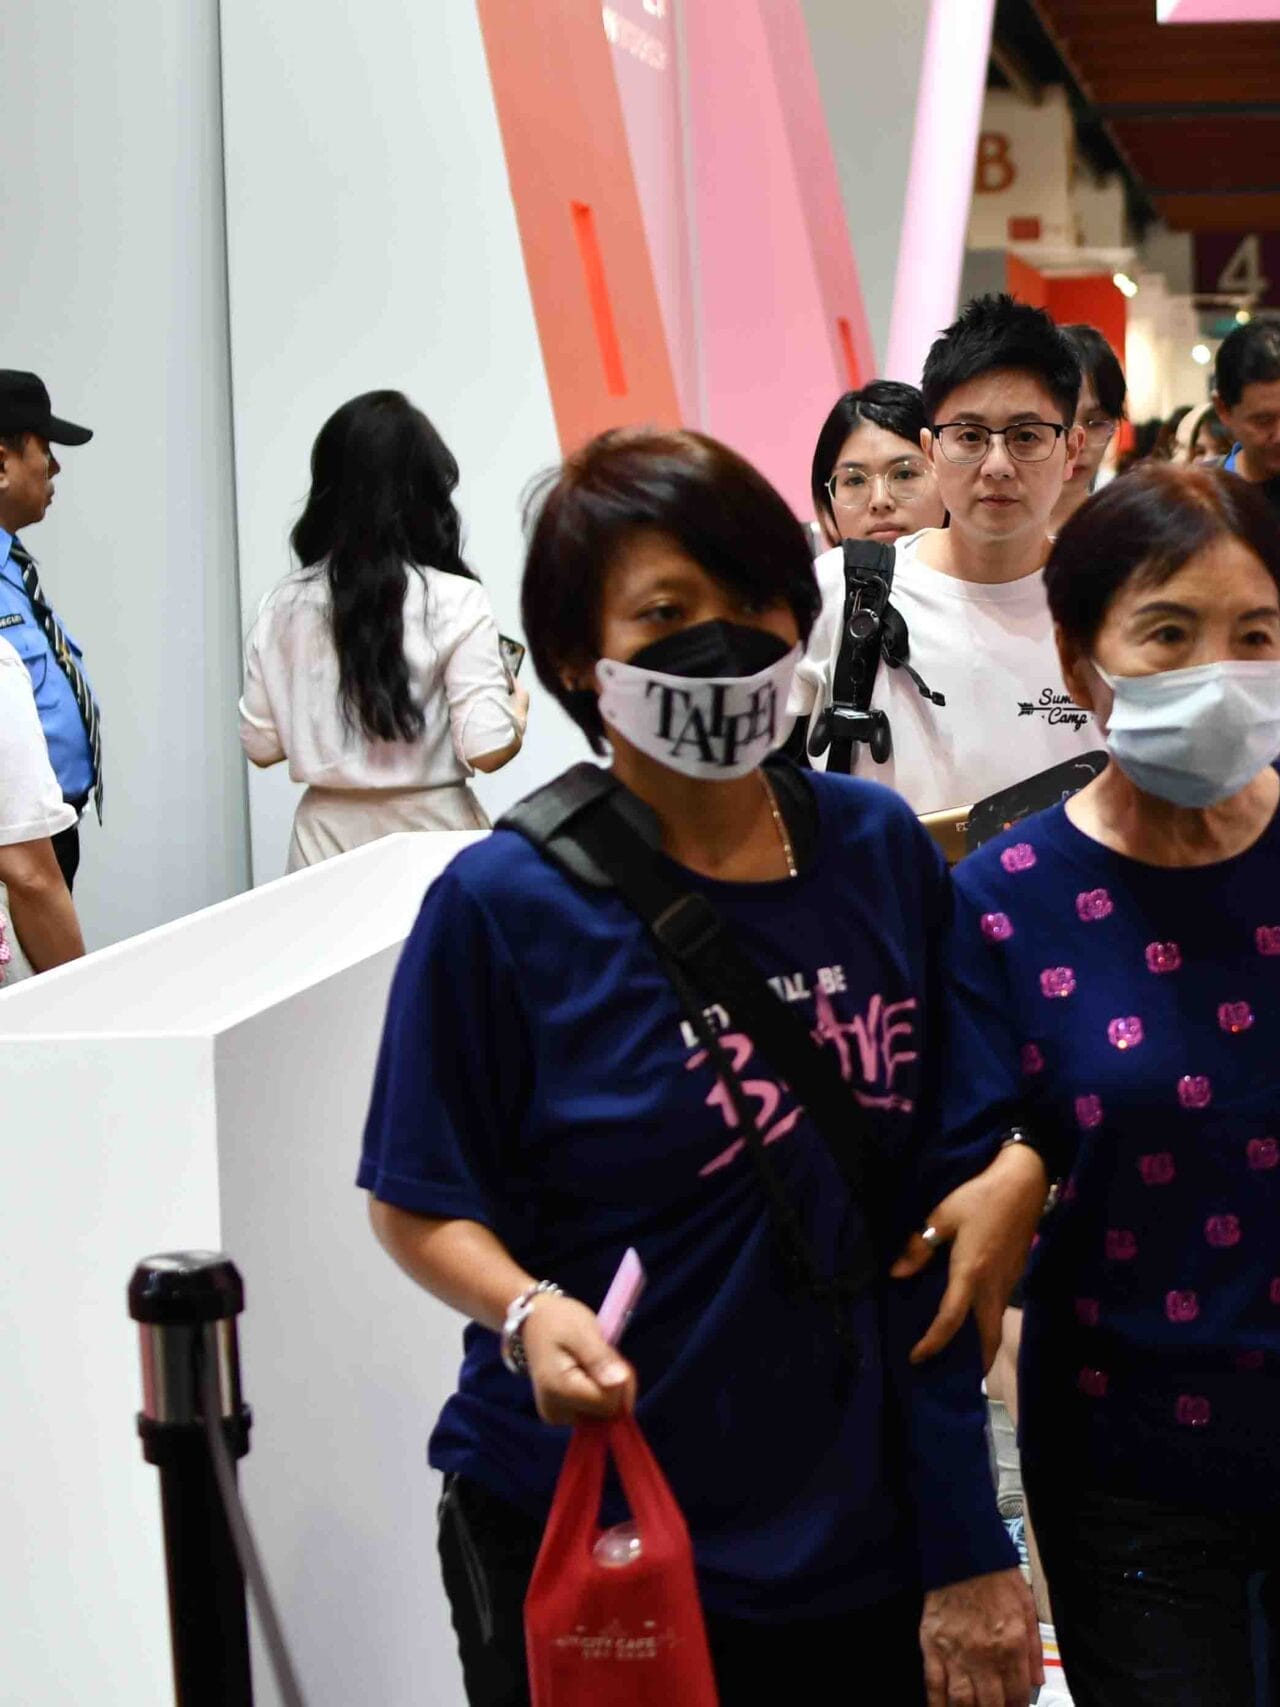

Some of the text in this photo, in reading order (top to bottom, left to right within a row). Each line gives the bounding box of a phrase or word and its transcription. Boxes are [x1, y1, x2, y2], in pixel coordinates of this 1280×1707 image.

[1220, 234, 1269, 303] 4
[646, 679, 777, 767] TAIPEI
[1048, 707, 1088, 732] Camp
[685, 984, 917, 1176] BAVE
